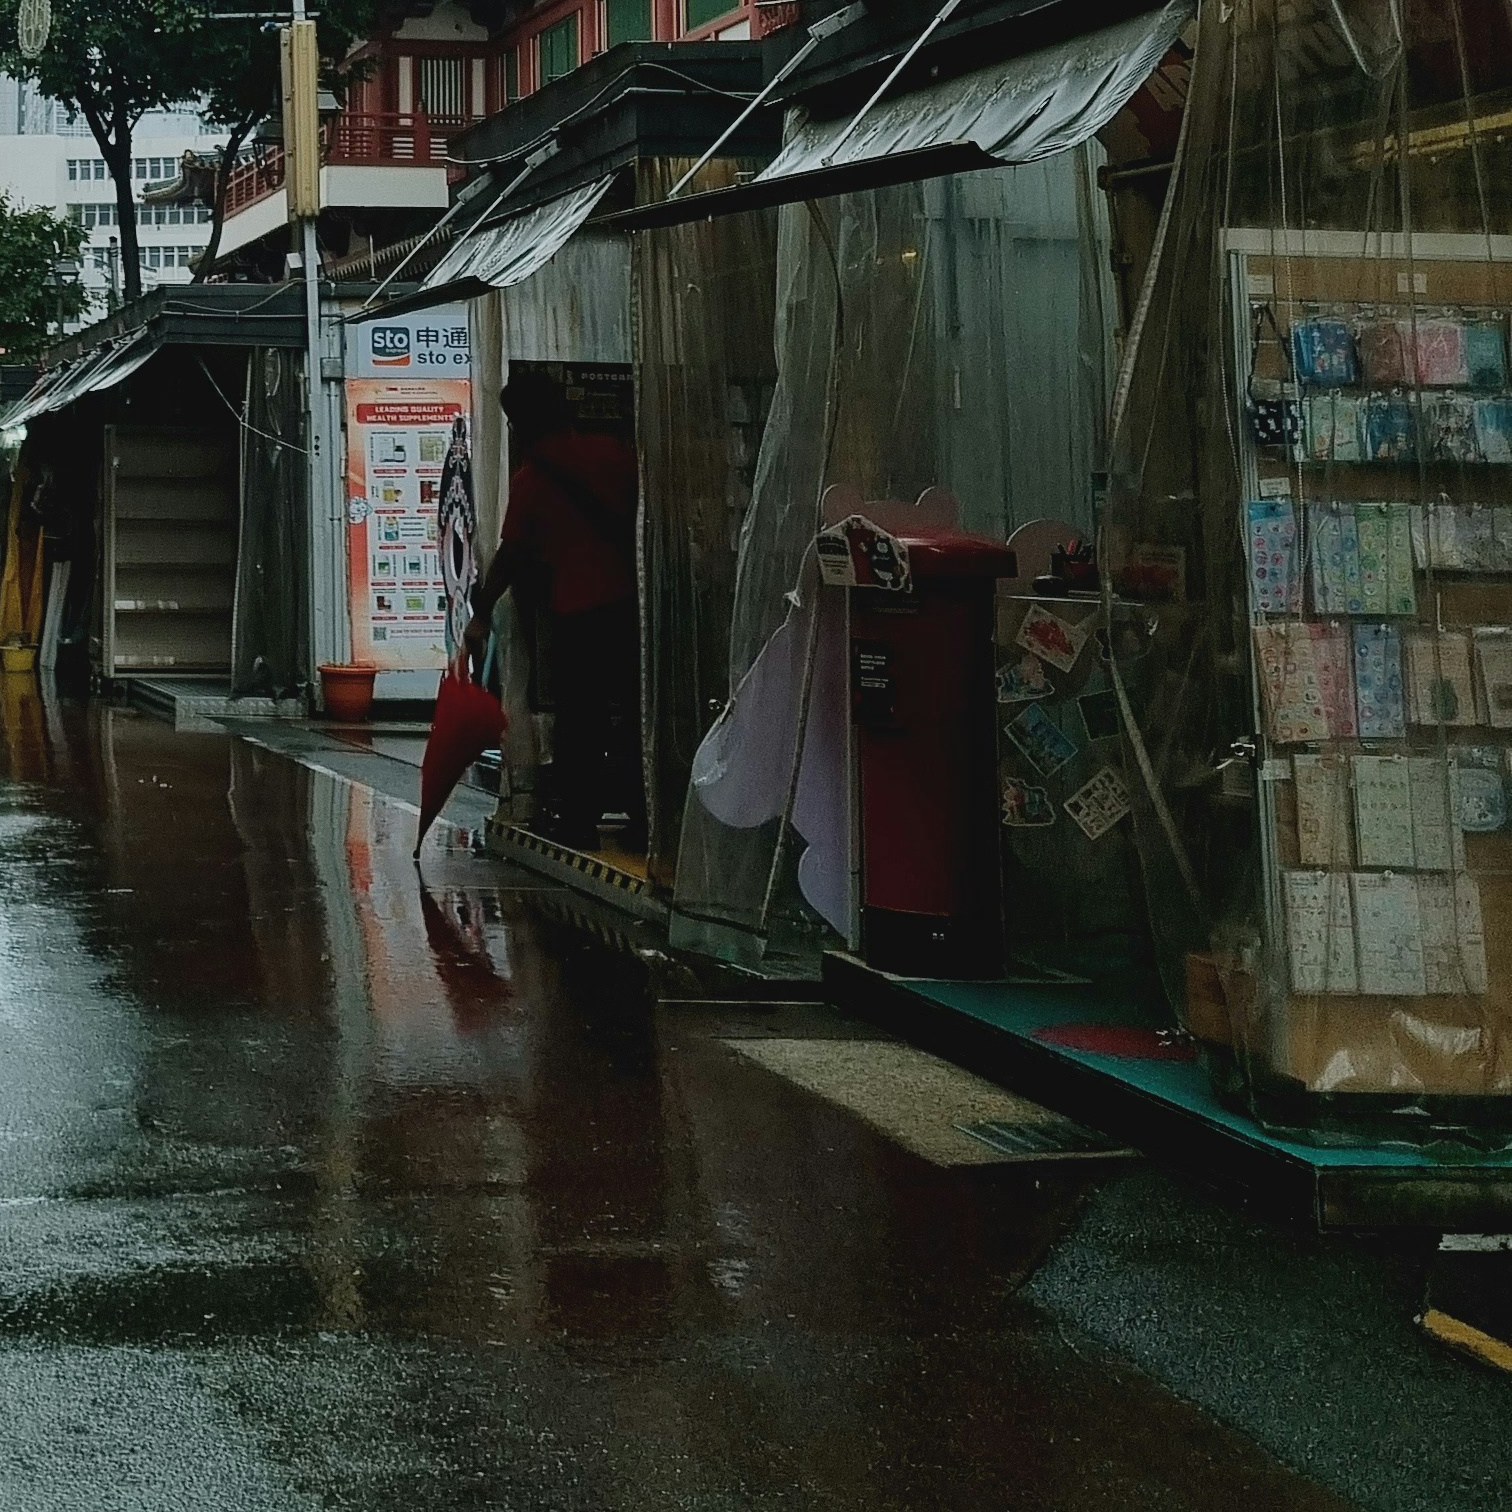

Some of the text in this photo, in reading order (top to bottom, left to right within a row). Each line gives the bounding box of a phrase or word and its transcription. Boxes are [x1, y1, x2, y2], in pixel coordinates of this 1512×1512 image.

[373, 329, 409, 348] sto
[416, 326, 470, 349] 申通
[417, 350, 447, 365] sto
[410, 405, 445, 414] QUALITY
[366, 414, 397, 422] HEALTH
